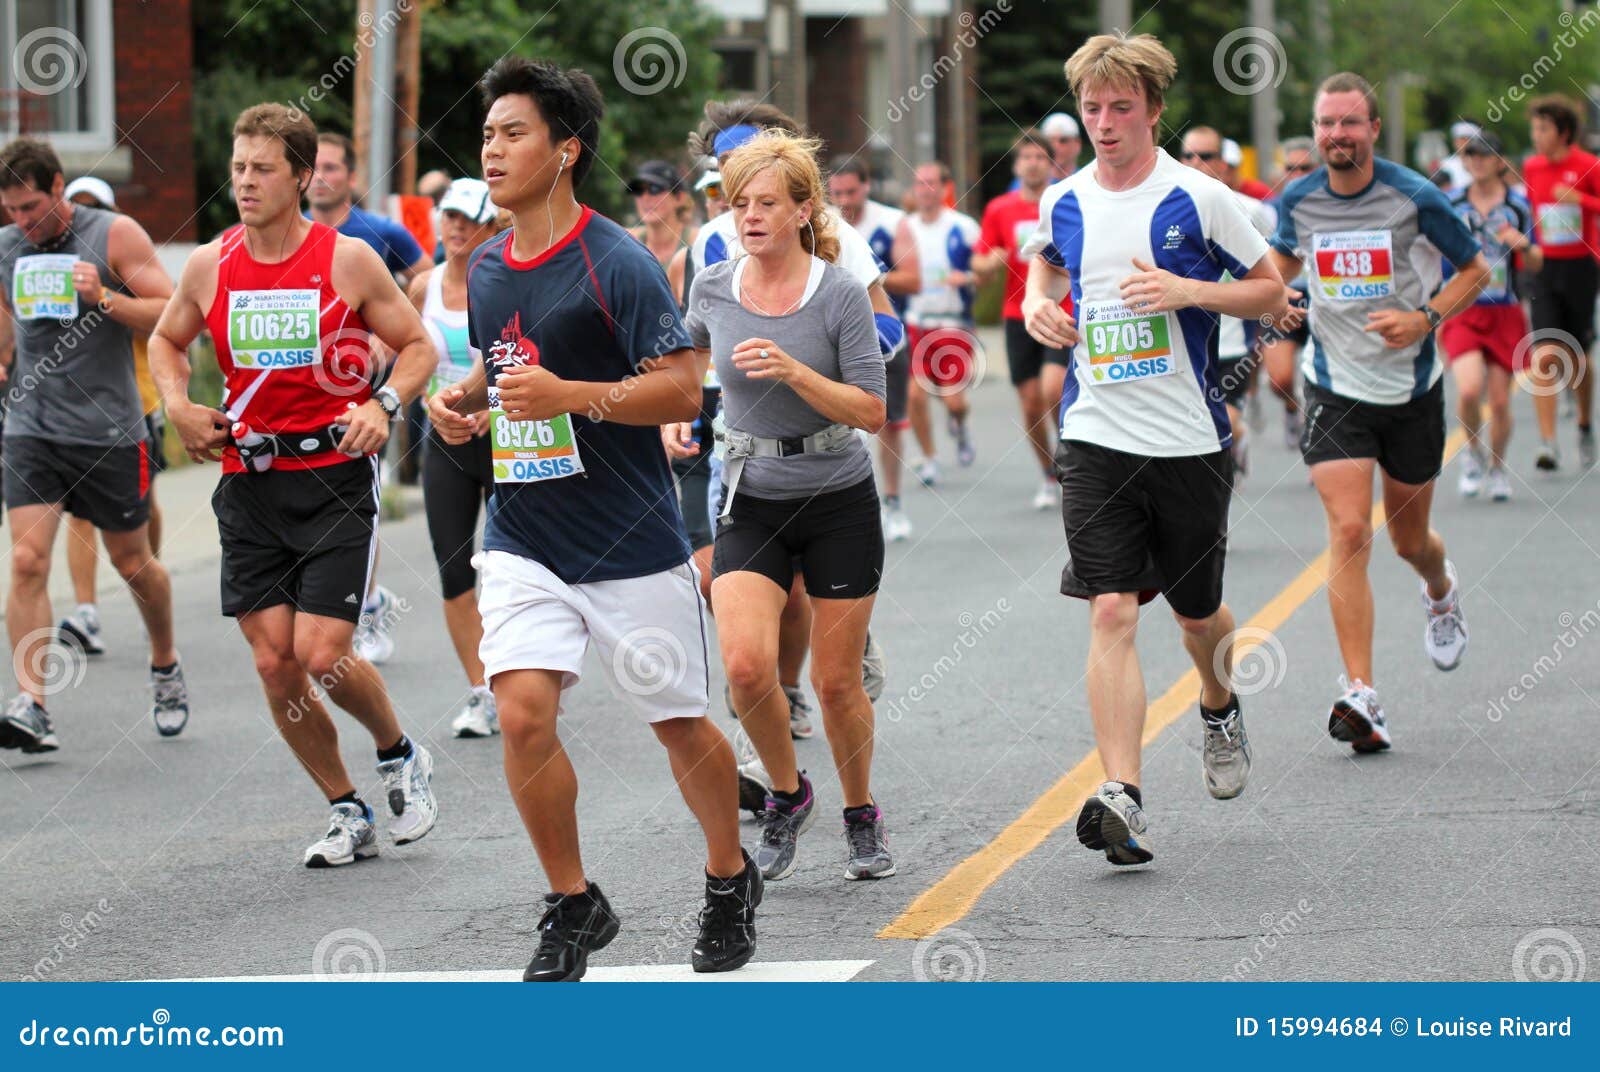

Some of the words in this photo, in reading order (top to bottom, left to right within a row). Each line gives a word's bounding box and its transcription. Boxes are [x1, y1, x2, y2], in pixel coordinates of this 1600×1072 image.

[1332, 251, 1373, 276] 438
[22, 273, 66, 297] 6895
[1341, 283, 1389, 297] OASIS
[236, 312, 311, 341] 10625
[1092, 321, 1154, 354] 9705
[257, 350, 314, 366] OASIS
[1108, 357, 1169, 380] OASIS
[495, 415, 555, 448] 8926
[513, 457, 574, 480] OASIS
